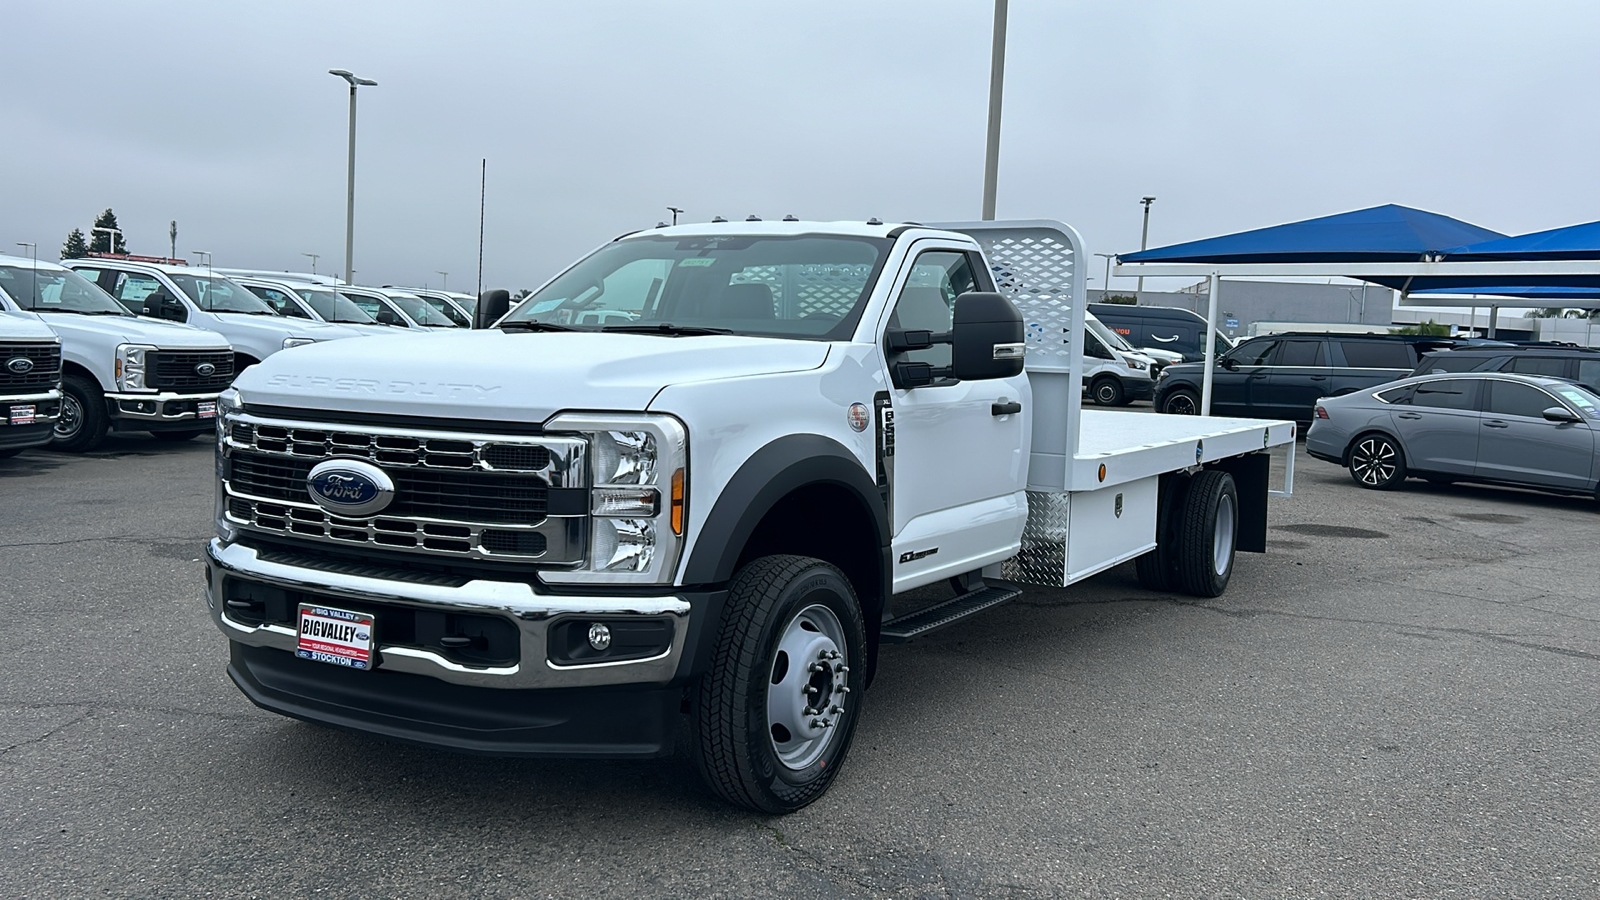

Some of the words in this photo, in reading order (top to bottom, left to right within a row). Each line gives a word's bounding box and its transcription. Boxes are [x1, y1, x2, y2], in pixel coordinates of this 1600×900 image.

[267, 374, 380, 393] SUPER
[388, 380, 502, 399] DUTY
[322, 474, 363, 499] Ford
[315, 607, 328, 616] BIG
[329, 610, 355, 620] VALLEY
[301, 619, 357, 643] BIGVALLEY
[311, 651, 352, 666] STOCKTON
